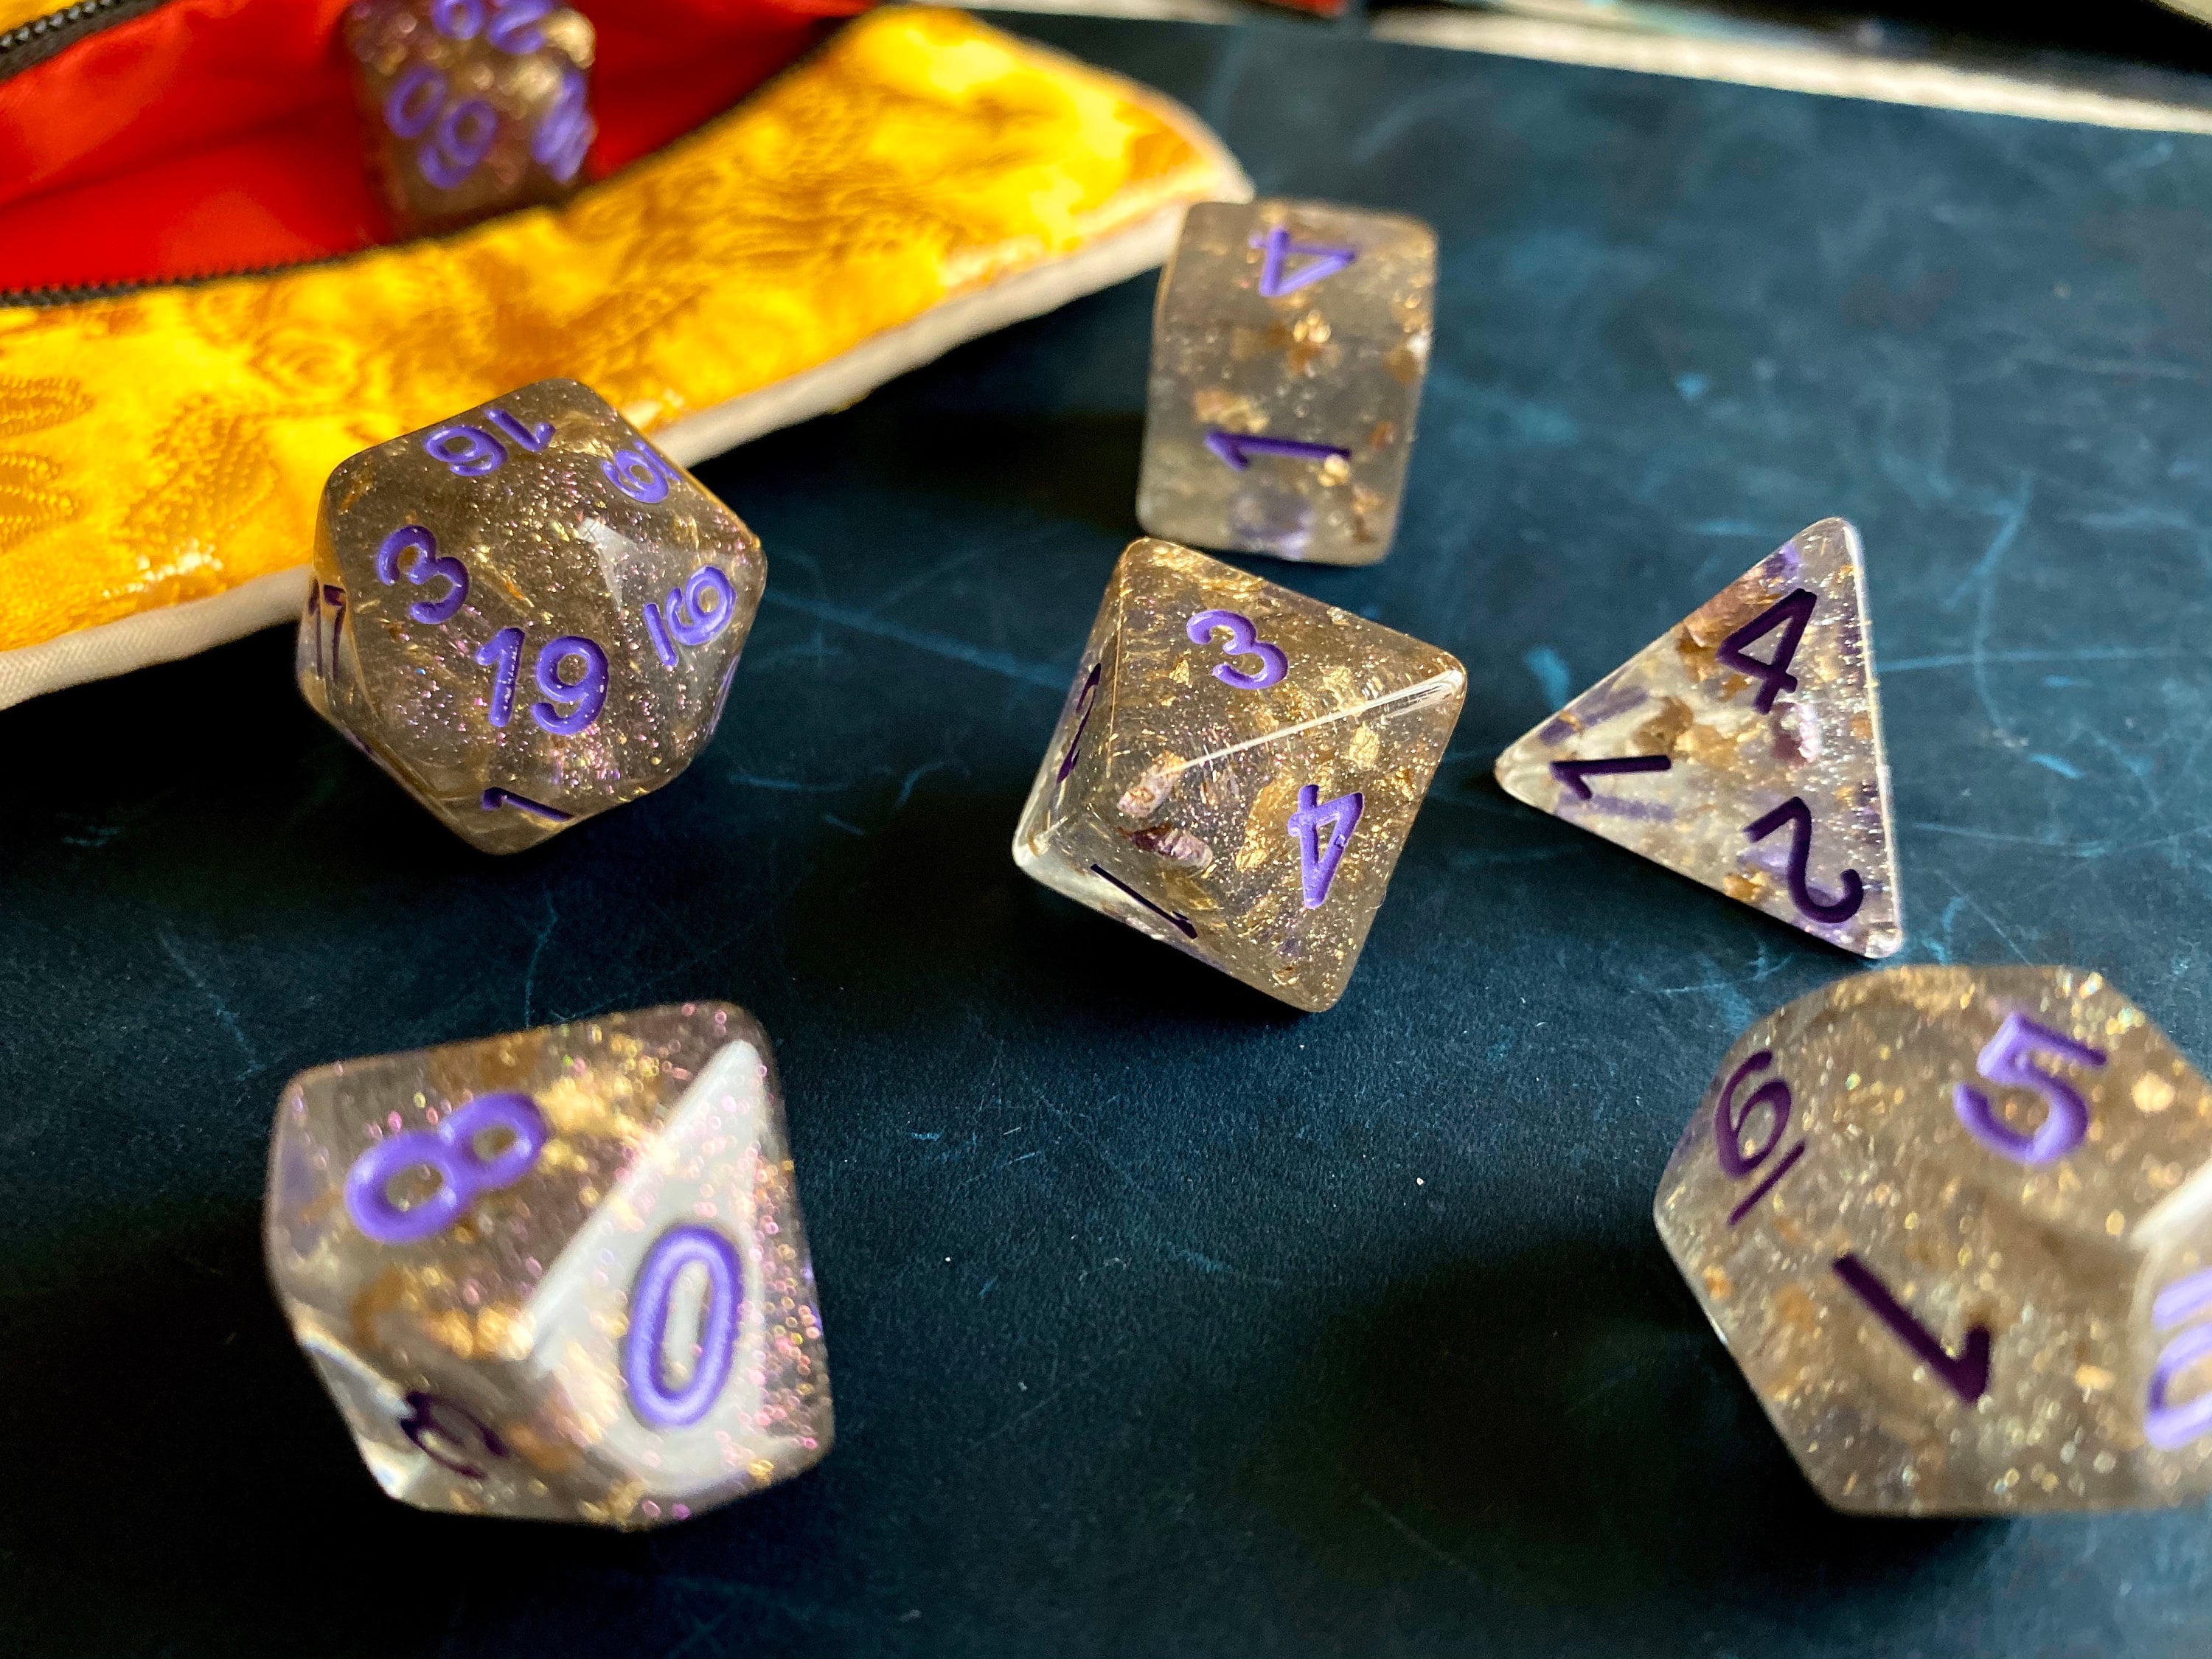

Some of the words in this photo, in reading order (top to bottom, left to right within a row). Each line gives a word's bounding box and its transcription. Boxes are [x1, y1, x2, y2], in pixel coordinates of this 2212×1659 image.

[1248, 230, 1358, 296] 4
[424, 408, 556, 477] 16
[1205, 428, 1352, 470] 1
[378, 524, 470, 625] 3
[475, 627, 609, 735] 19
[1186, 609, 1290, 689] 3
[1717, 588, 1817, 714] 4
[1548, 754, 1672, 799] 1
[1287, 784, 1366, 909] 4
[1742, 796, 1864, 923] 2
[1952, 1012, 2107, 1165] 5
[345, 1093, 549, 1245] 8
[626, 1224, 743, 1430] 0
[1832, 1252, 1992, 1406] 1
